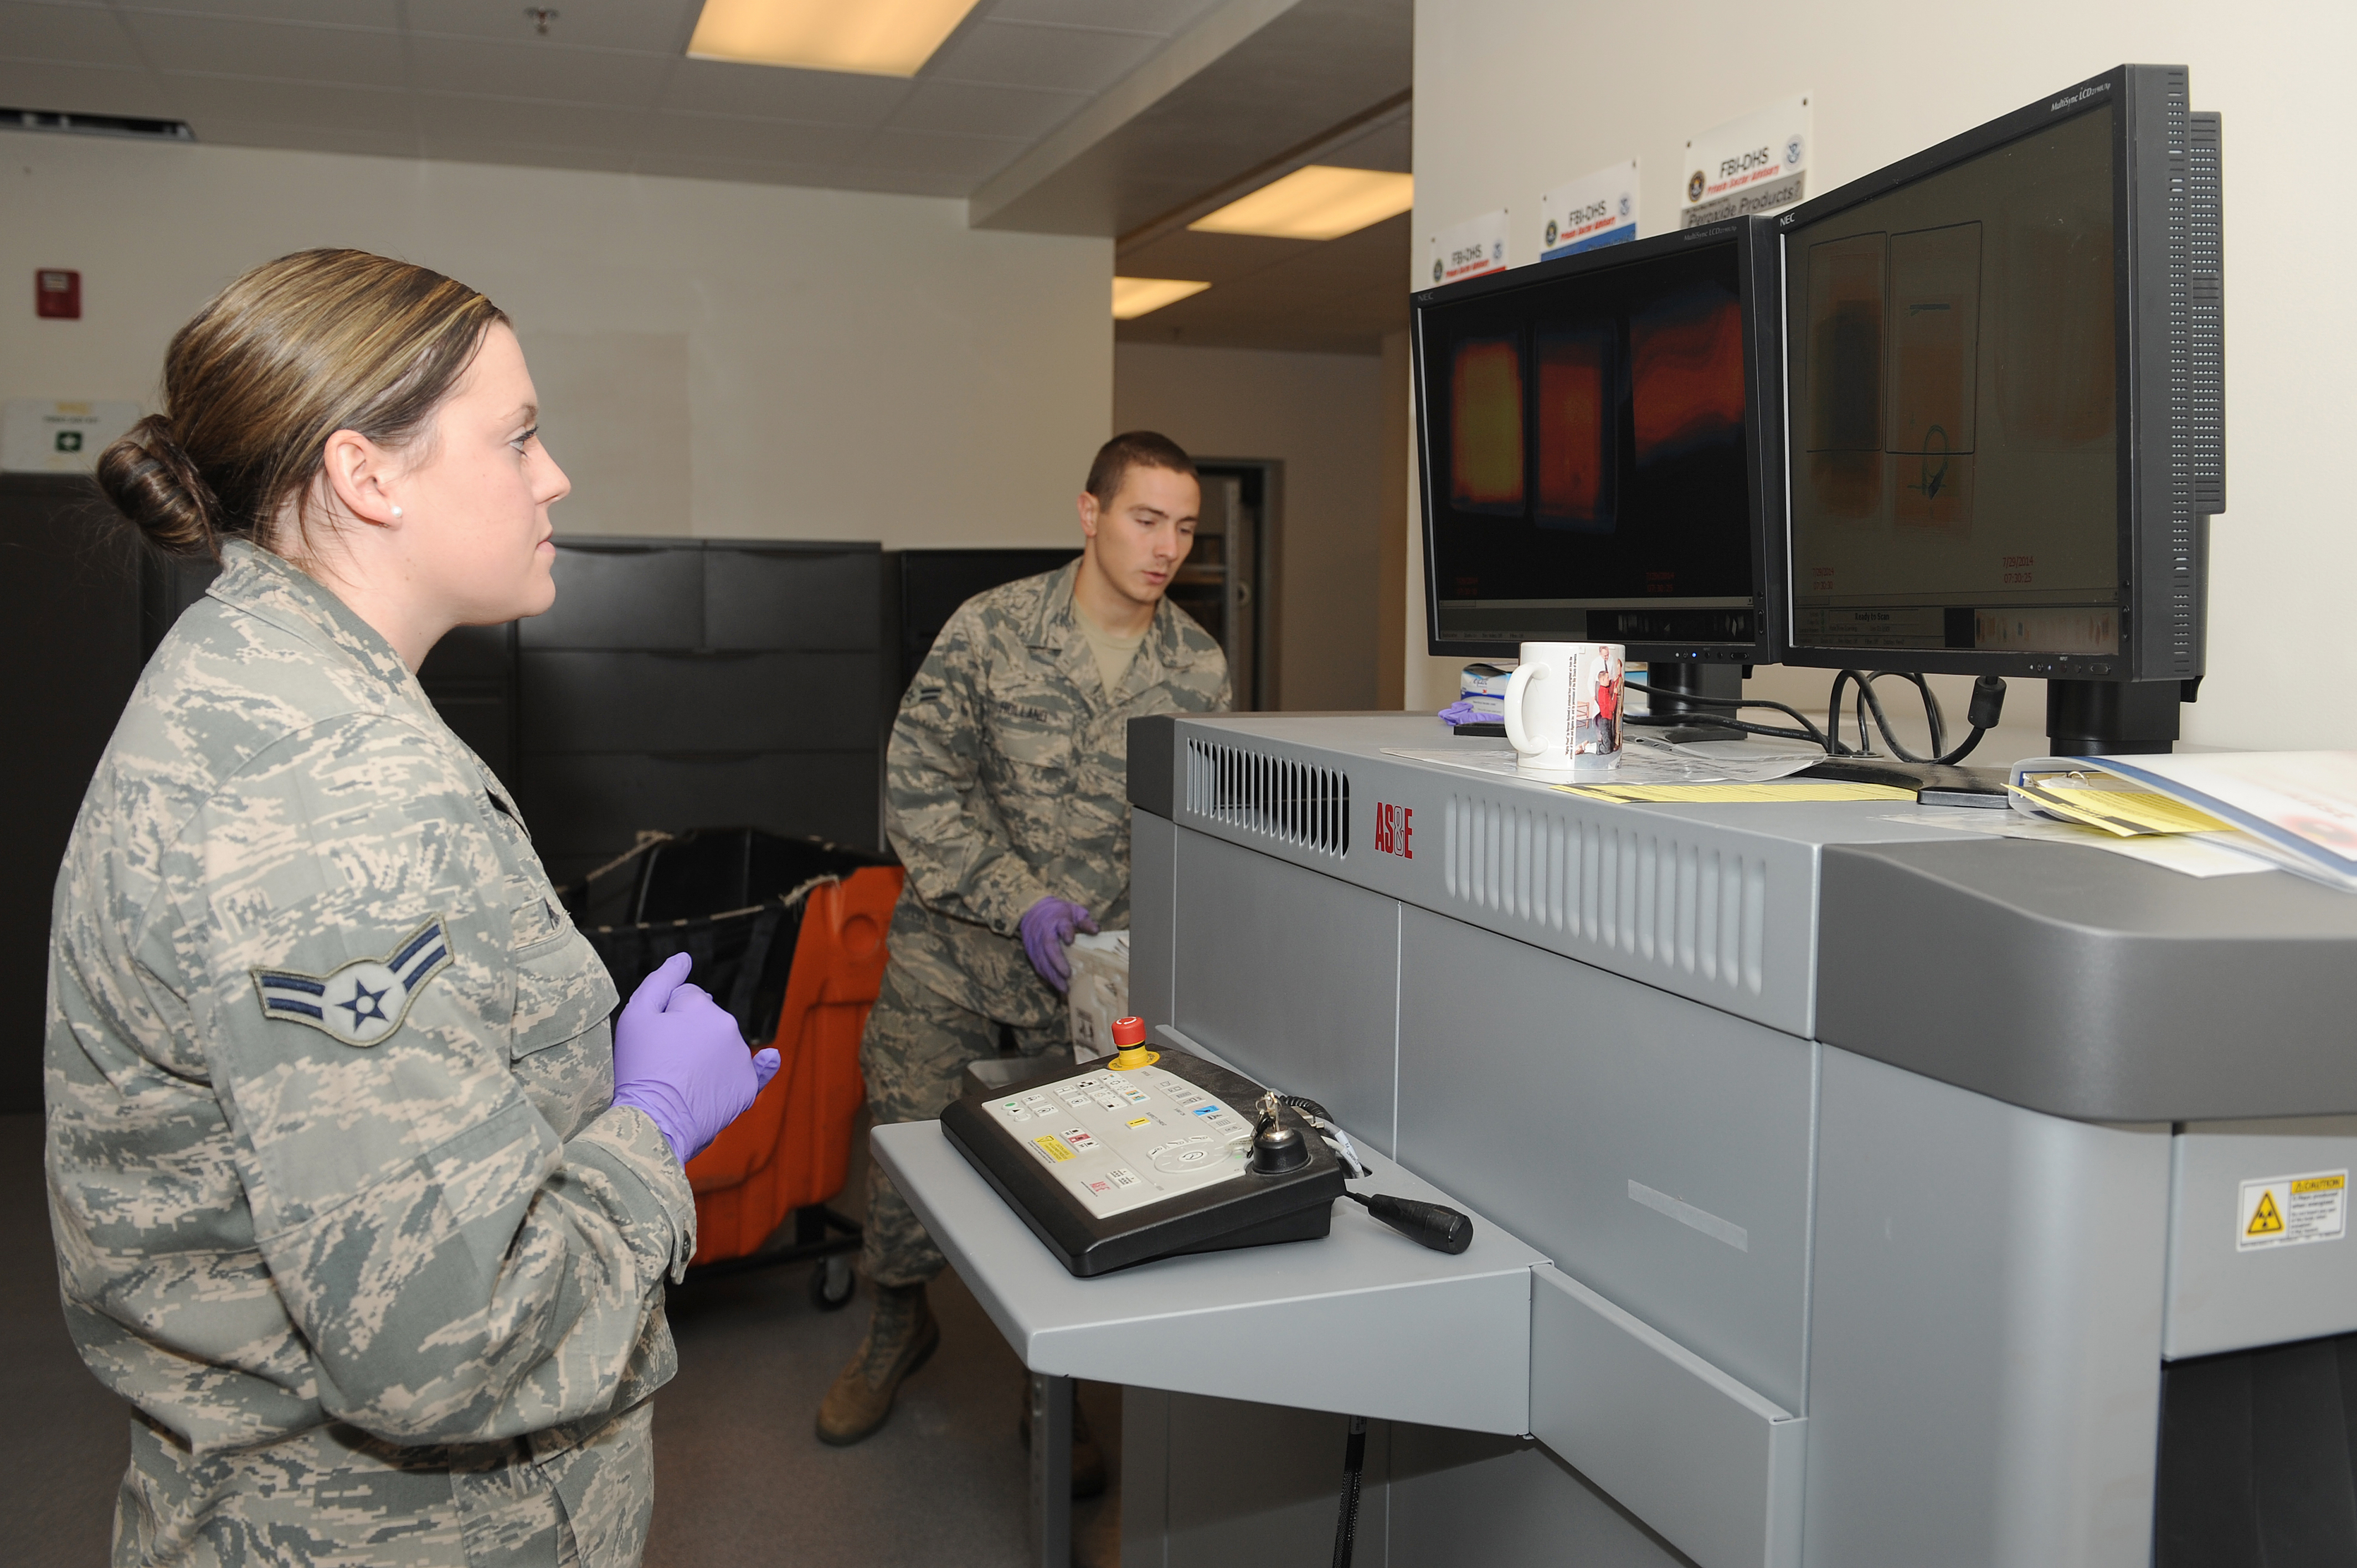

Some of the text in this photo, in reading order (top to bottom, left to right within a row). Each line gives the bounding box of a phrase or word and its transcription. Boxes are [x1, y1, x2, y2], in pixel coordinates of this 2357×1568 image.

[2051, 95, 2078, 112] MultiSync
[1720, 146, 1769, 178] FBI-DHS
[1739, 179, 1802, 214] Products?
[1569, 200, 1606, 226] FBI-DHS
[1779, 212, 1795, 227] NEC
[1418, 292, 1434, 302] NEC
[2002, 555, 2034, 569] 7/29/2014
[2004, 572, 2032, 584] 07:30:25
[1855, 612, 1870, 622] Ready
[1375, 802, 1413, 859] AS&E
